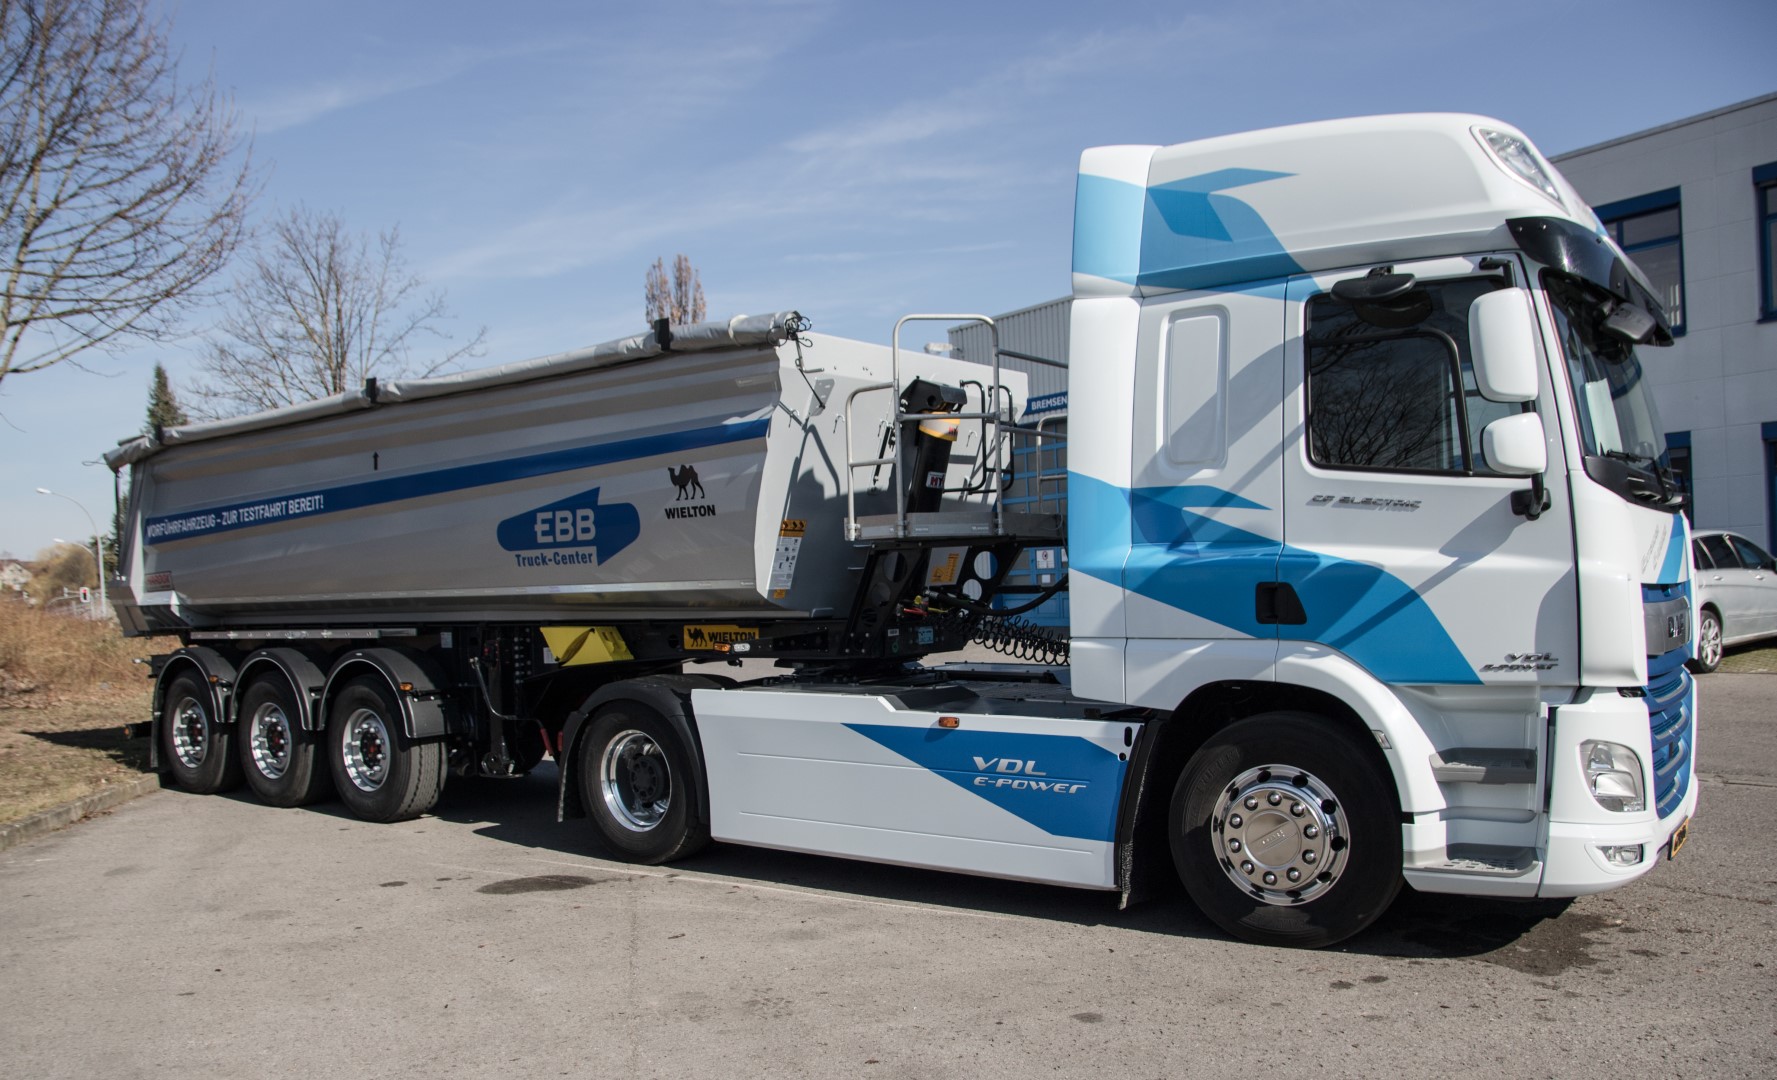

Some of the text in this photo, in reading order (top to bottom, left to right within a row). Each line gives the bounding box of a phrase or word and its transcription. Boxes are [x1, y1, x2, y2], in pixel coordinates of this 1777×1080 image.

[1031, 395, 1067, 411] BREMSEN
[146, 513, 217, 538] VORFÜHRFAHRZEUG
[221, 509, 239, 527] ZUR
[239, 501, 288, 523] TESTFAHRT
[288, 494, 325, 515] BEREIT!
[664, 504, 717, 520] WIELTON
[534, 508, 596, 544] EBB
[515, 550, 593, 567] Truck-Center
[707, 631, 756, 642] WIELTON
[1508, 652, 1559, 662] VDL
[972, 756, 1047, 776] VDL
